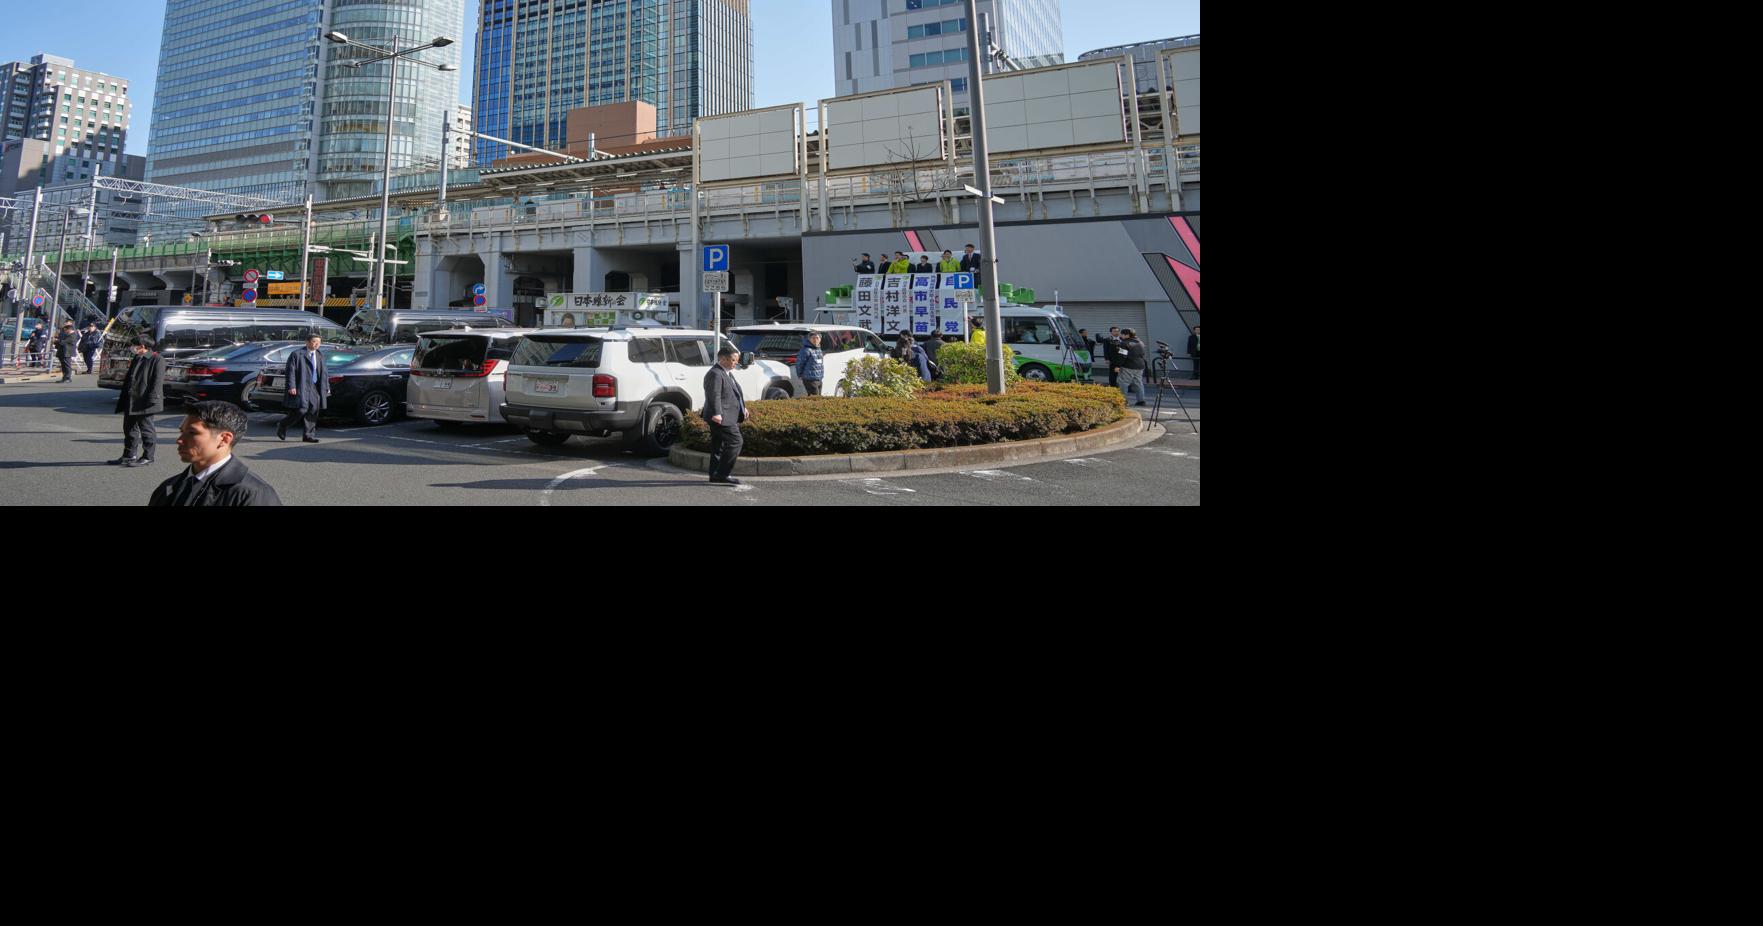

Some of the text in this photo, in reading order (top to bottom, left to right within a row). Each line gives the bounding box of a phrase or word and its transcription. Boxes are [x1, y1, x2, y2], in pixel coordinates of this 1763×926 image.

[709, 248, 724, 269] P
[958, 274, 970, 288] P
[574, 294, 627, 308] 日本維新の会
[858, 277, 872, 330] 藤田文武
[885, 277, 901, 331] 吉村洋文
[914, 276, 929, 332] 高市早苗
